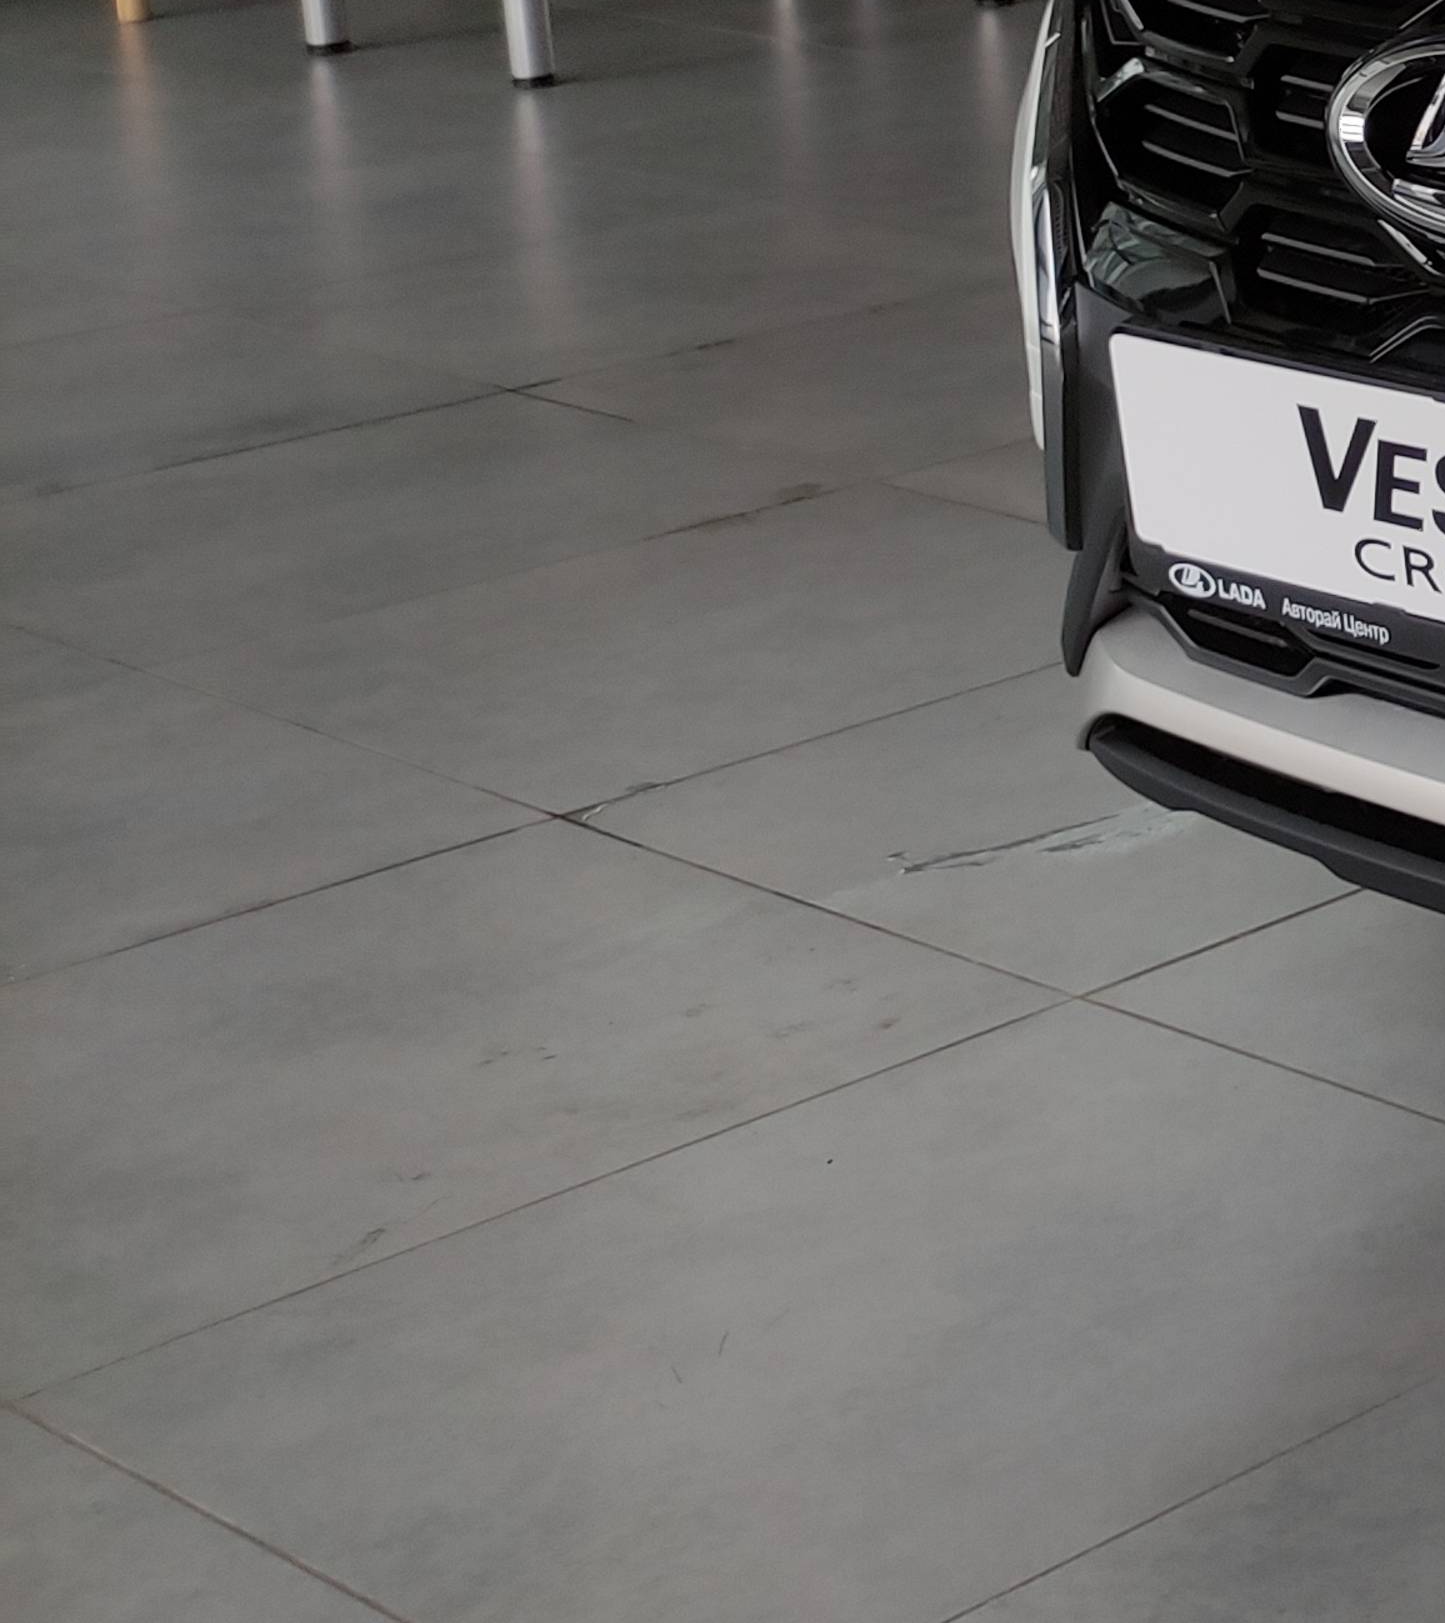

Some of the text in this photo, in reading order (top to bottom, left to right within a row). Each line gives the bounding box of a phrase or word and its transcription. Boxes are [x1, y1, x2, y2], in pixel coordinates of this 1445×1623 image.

[1217, 579, 1267, 609] LADA
[1281, 598, 1390, 645] Авторай Центр
